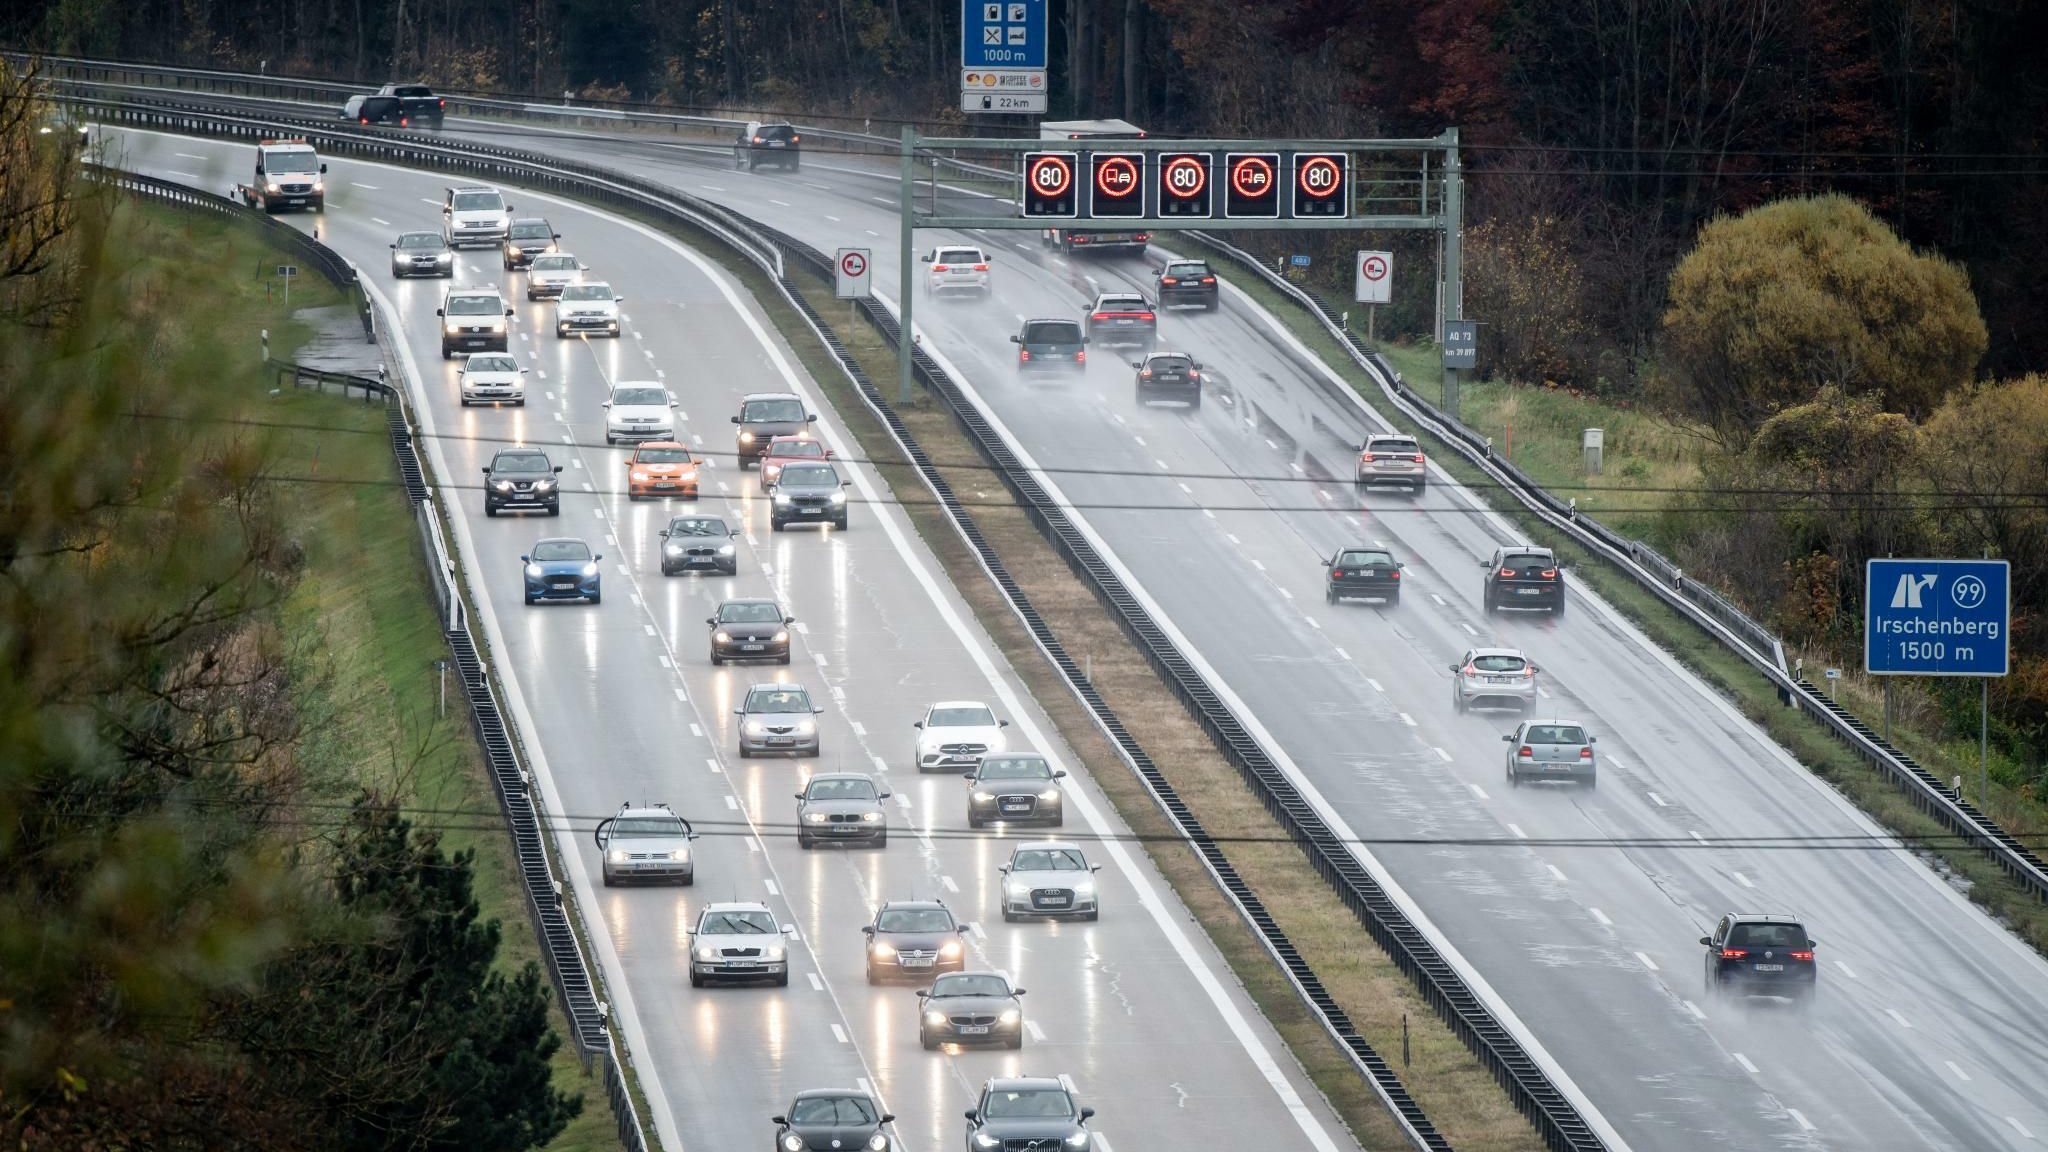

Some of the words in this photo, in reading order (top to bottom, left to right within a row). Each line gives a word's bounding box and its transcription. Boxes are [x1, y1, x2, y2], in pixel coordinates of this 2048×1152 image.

[984, 49, 1011, 61] 1000
[1014, 52, 1026, 61] m
[1000, 98, 1011, 107] 22
[1013, 98, 1029, 107] km
[1039, 167, 1062, 186] 80
[1174, 168, 1197, 187] 80
[1309, 168, 1332, 187] 80
[1449, 331, 1459, 341] AQ
[1462, 331, 1472, 341] 73
[1445, 348, 1455, 356] km
[1957, 583, 1981, 601] 99
[1876, 615, 1999, 640] Irschenberg
[1899, 641, 1945, 660] 1500
[1955, 647, 1974, 661] m
